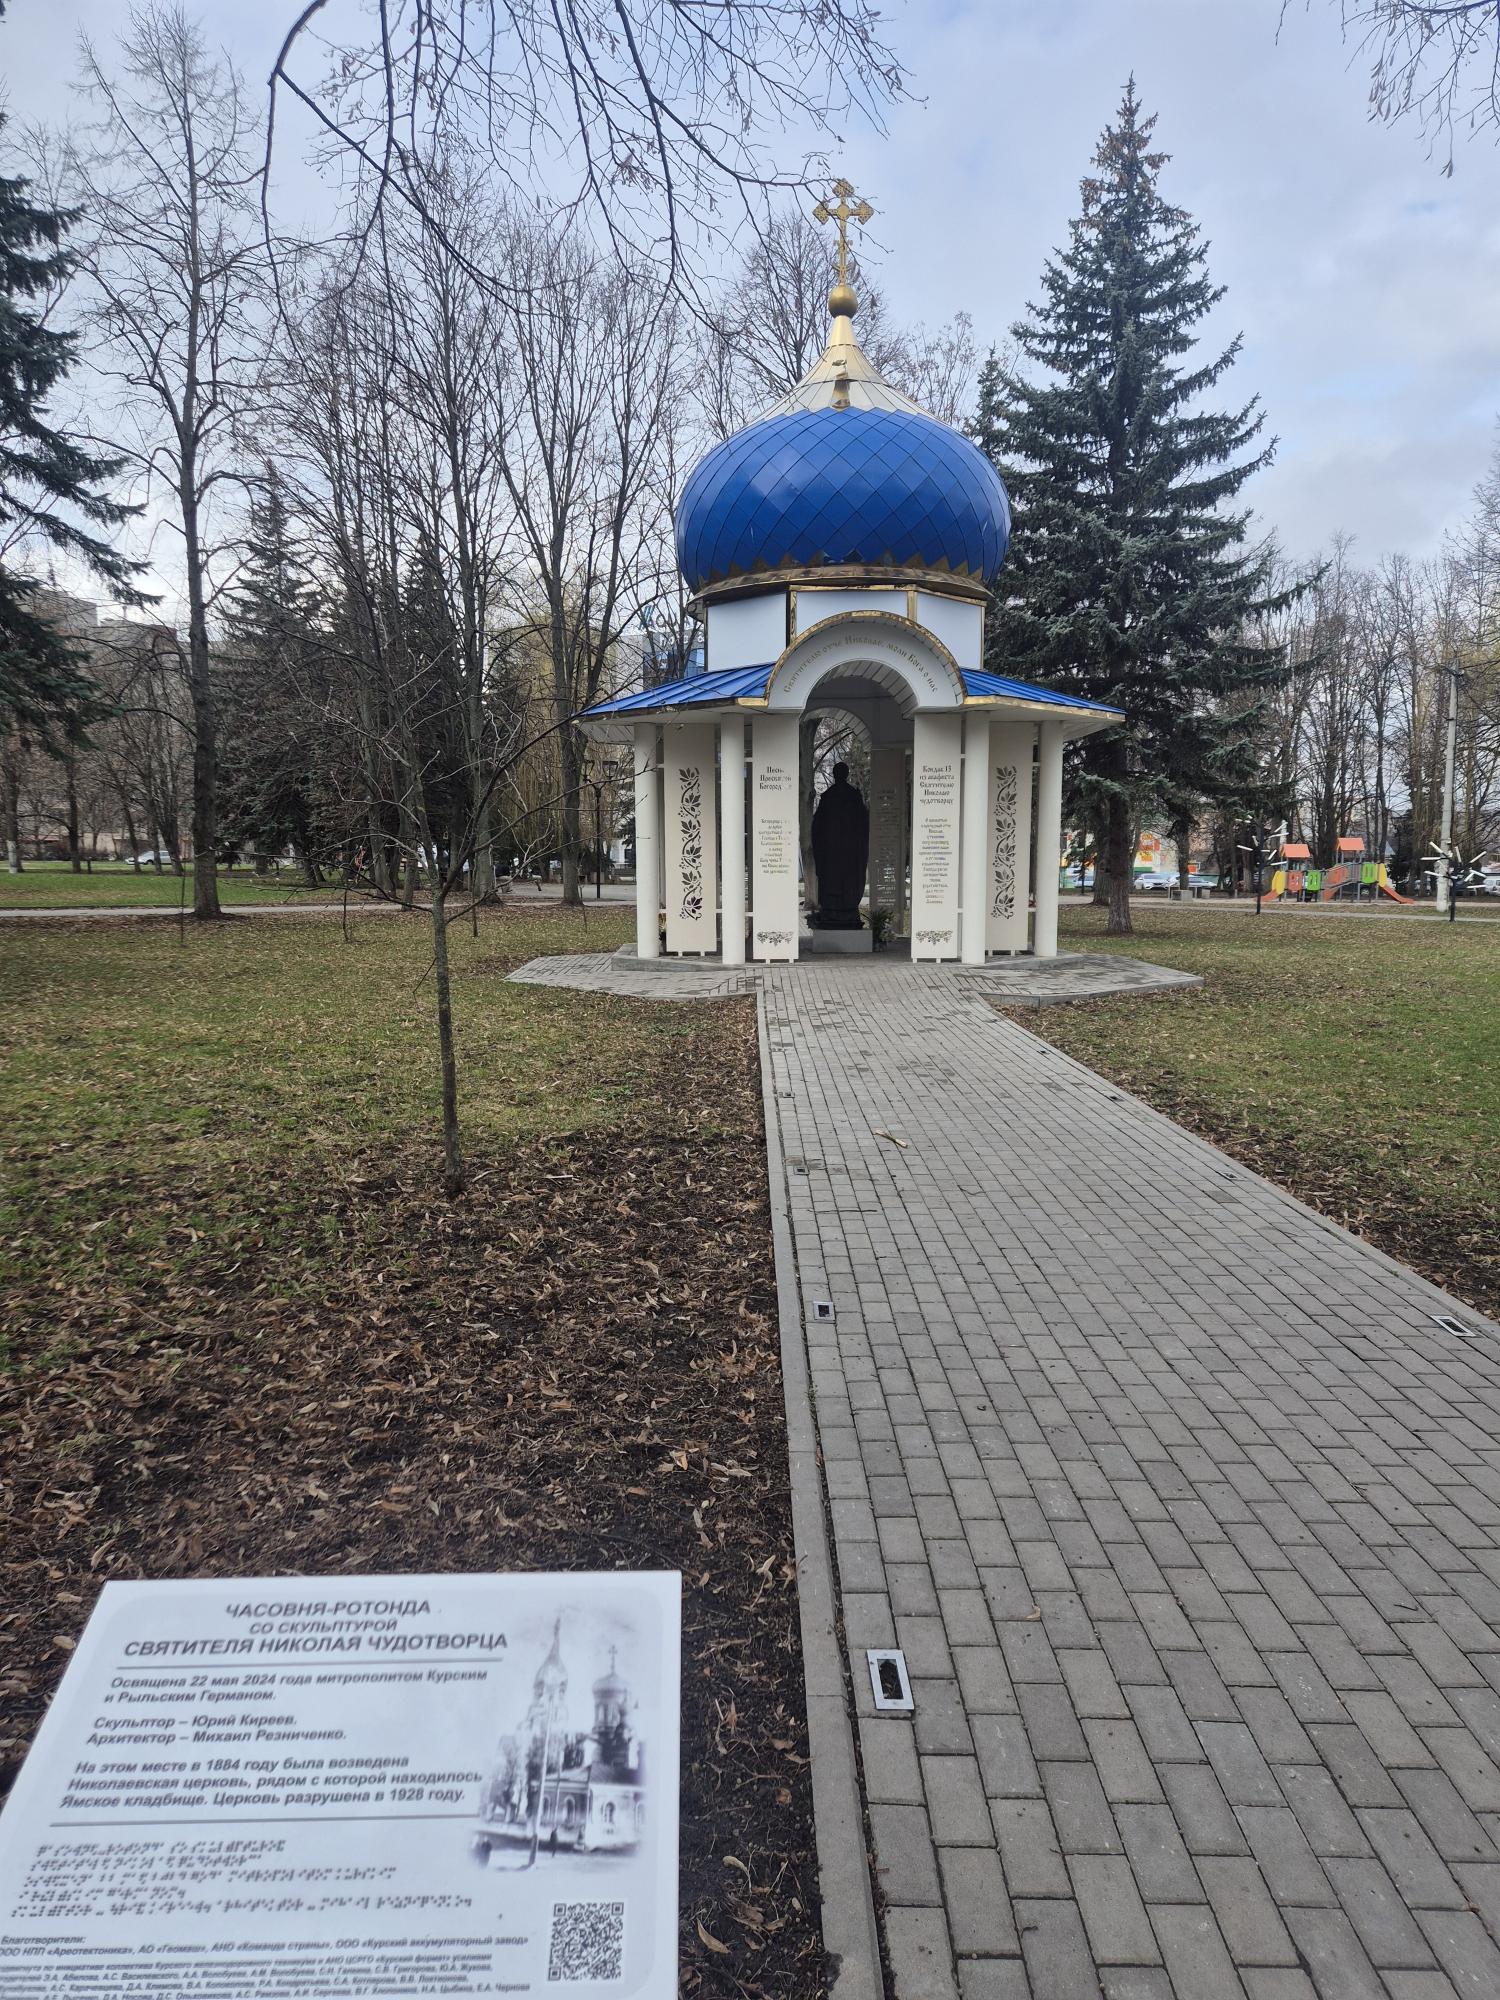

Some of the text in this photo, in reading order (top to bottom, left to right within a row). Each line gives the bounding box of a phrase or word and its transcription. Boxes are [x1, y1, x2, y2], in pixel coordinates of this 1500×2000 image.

[226, 1600, 431, 1617] ЧАСОВНЯ-РОТОНДА
[250, 1619, 397, 1635] СО СКУЛЬПТУРОЙ
[124, 1633, 508, 1656] СВЯТИТЕЛЯ НИКОЛАЯ ЧУДОТВОРЦА
[111, 1669, 487, 1689] Освящена 22 мая 2024 года митрополитом Курским
[105, 1690, 276, 1704] и Рыльским Германом.
[94, 1716, 175, 1731] Скульптор
[192, 1714, 236, 1729] Юрий
[240, 1714, 297, 1726] Киреев.
[87, 1731, 175, 1746] Архитектор
[193, 1730, 251, 1743] Михаил
[255, 1729, 347, 1742] Резниченко.
[75, 1756, 409, 1774] На этом месте в 1884 году была возведена
[67, 1770, 482, 1792] Николаевская церковь, рядом с которой находилось
[59, 1787, 466, 1808] Ямское кладбище. Церковь разрушена в 1928 году.
[1, 1935, 86, 1947] Благотворители:
